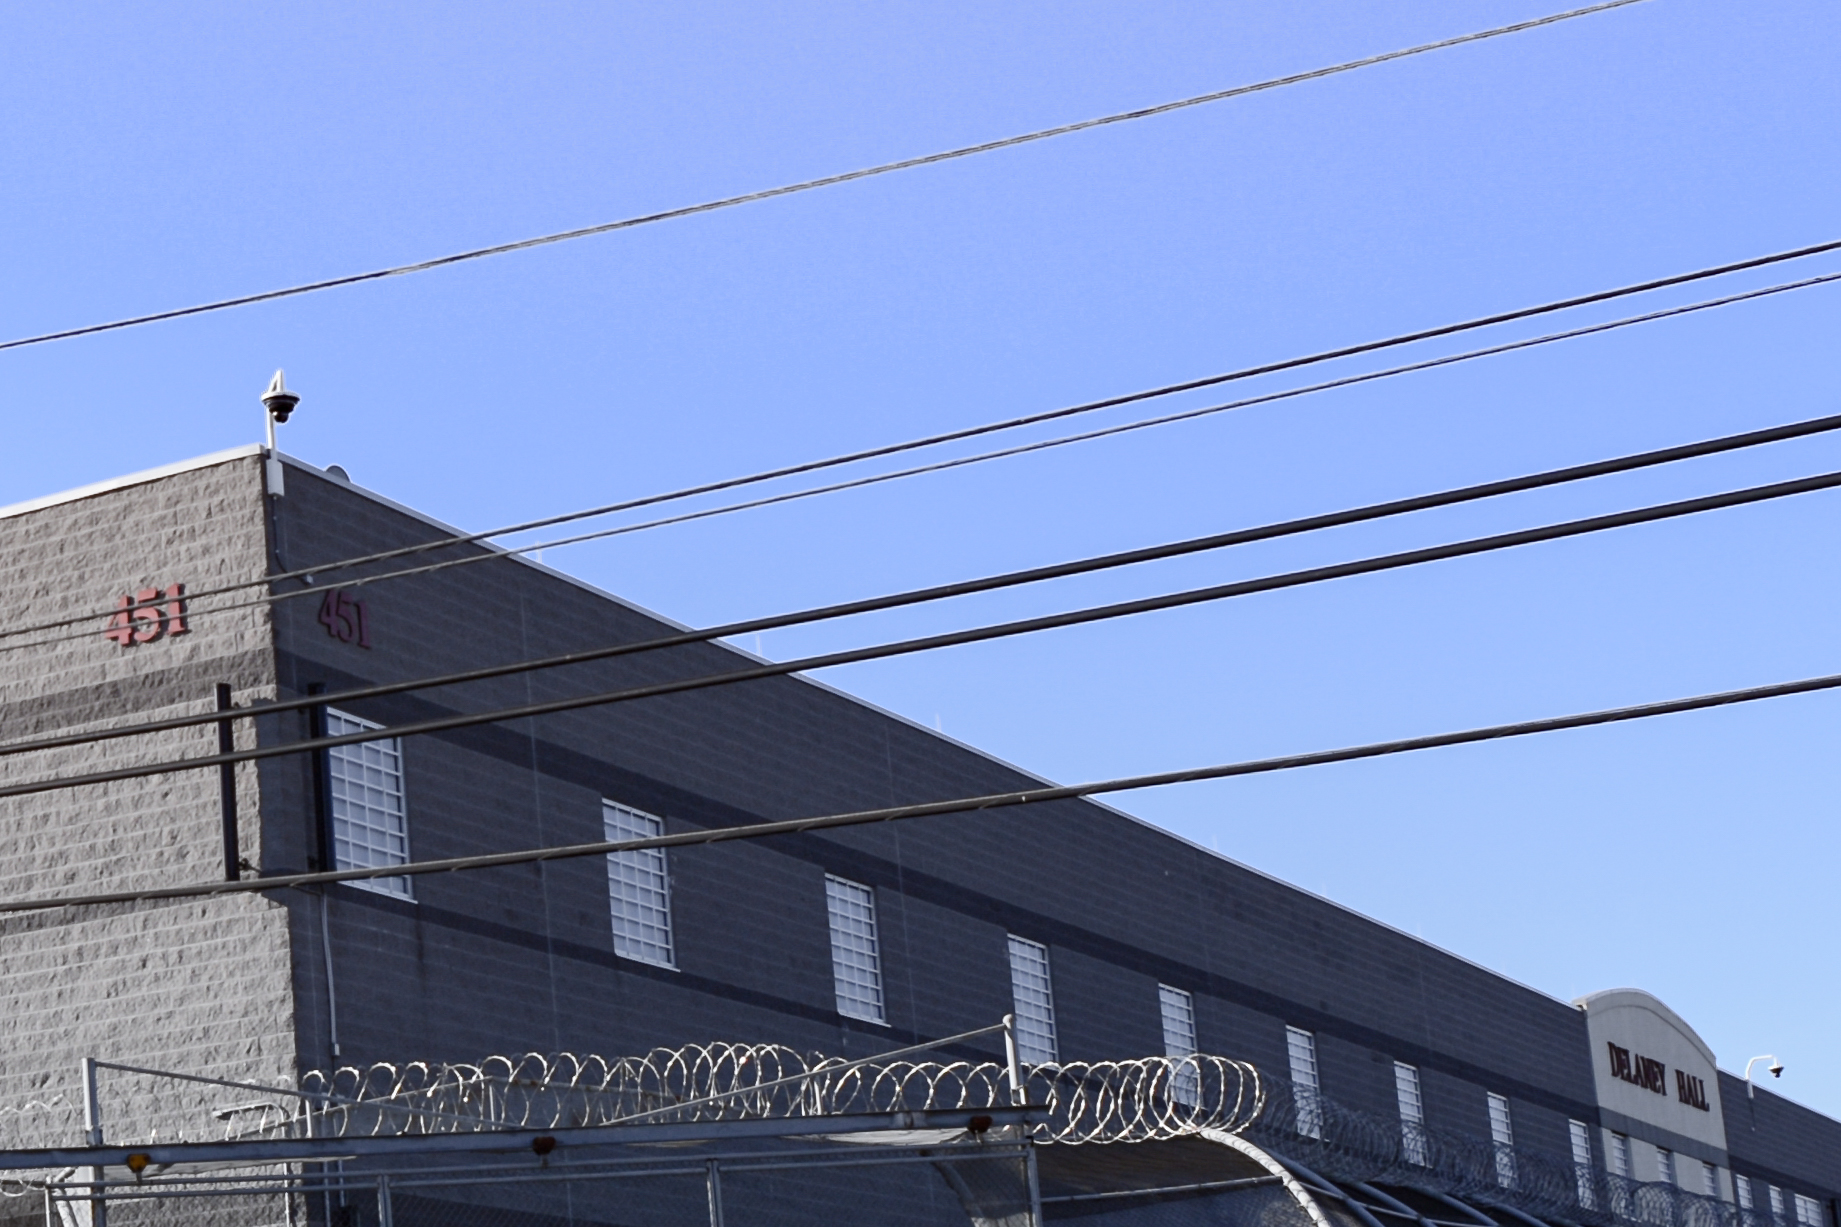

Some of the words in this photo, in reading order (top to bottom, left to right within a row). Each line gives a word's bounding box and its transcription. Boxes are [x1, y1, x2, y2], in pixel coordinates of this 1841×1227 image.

[105, 583, 187, 646] 451
[317, 588, 370, 649] 451
[1607, 1041, 1667, 1096] DELANEY
[1675, 1069, 1710, 1112] HALL
